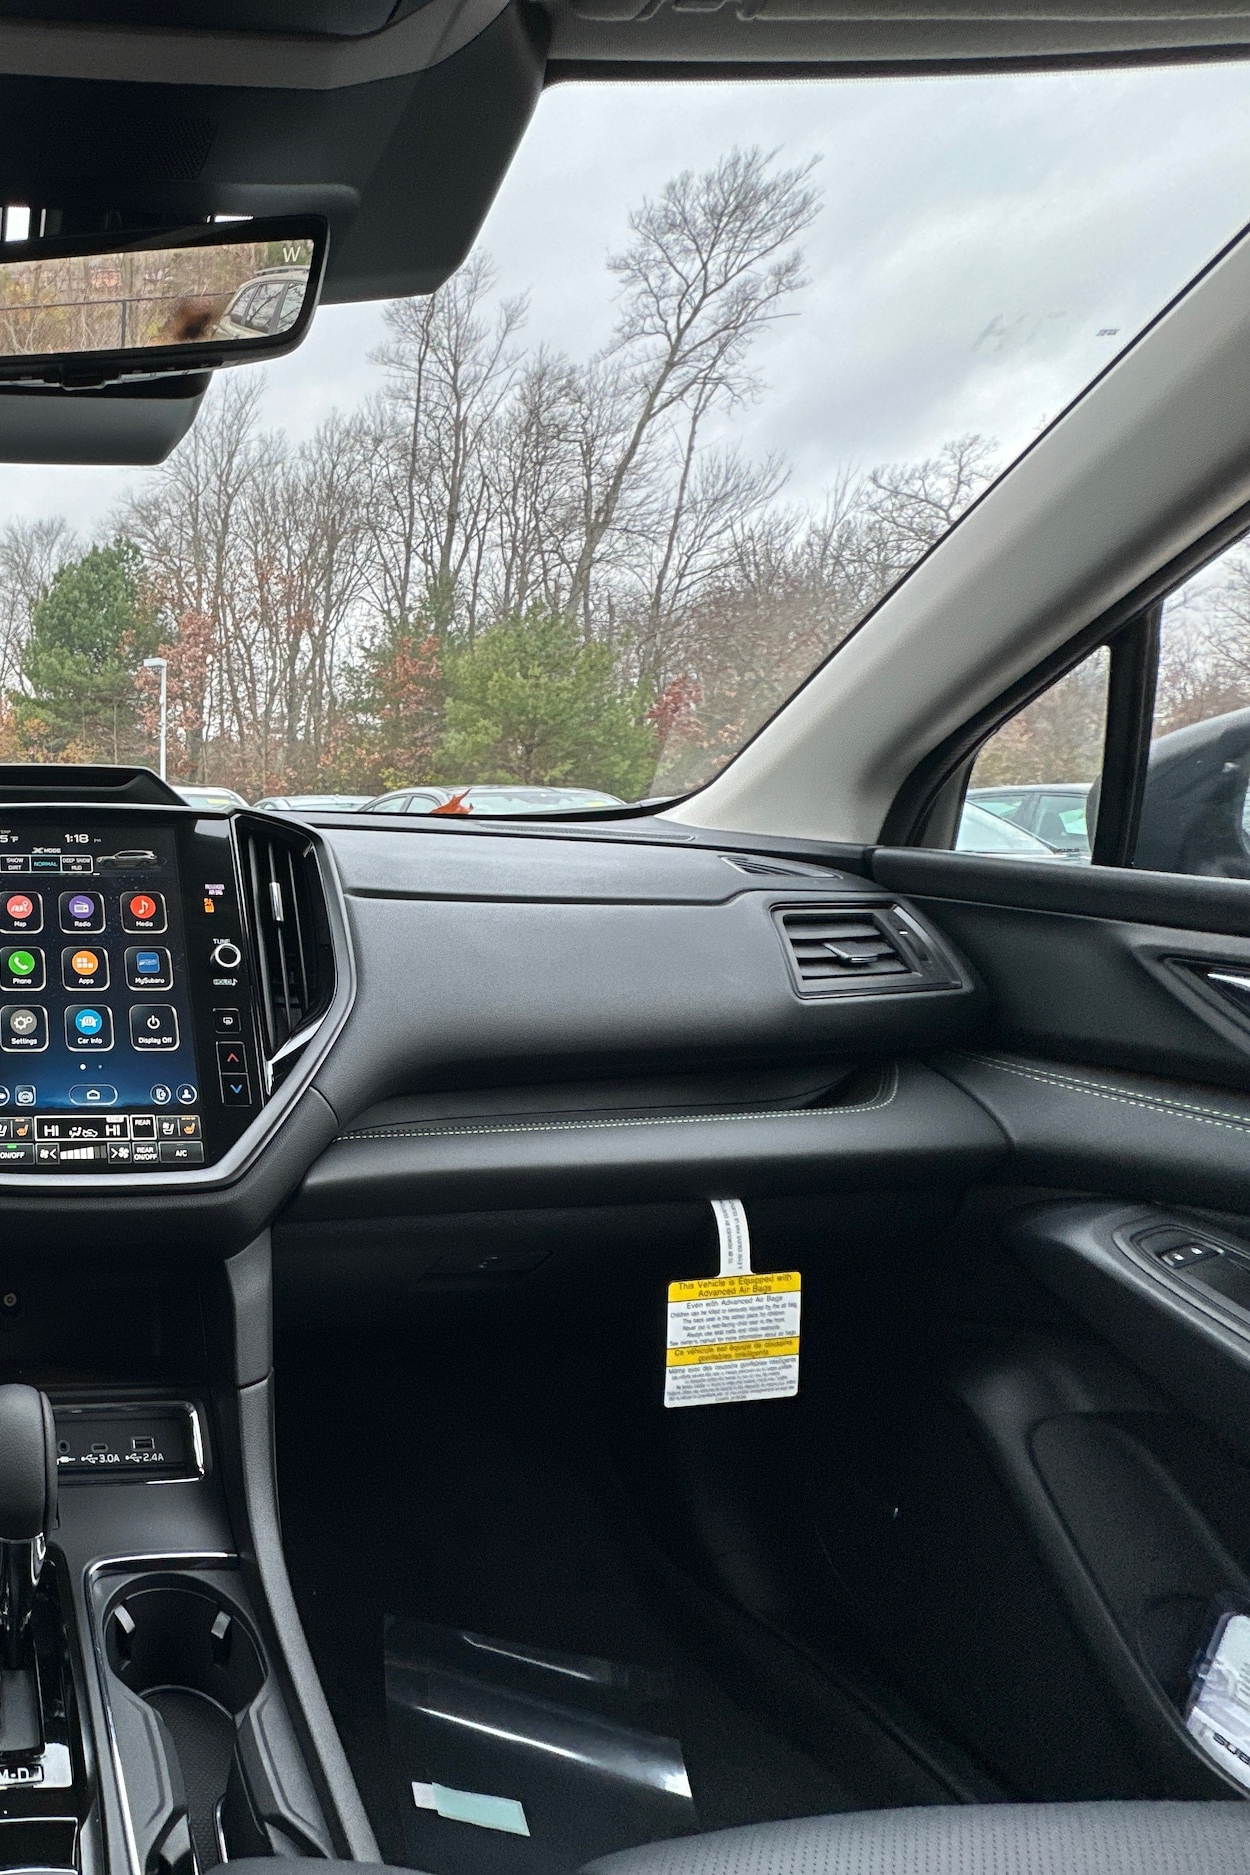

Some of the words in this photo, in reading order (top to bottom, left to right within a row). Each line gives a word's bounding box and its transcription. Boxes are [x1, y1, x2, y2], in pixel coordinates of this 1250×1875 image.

[283, 246, 301, 262] W
[65, 834, 89, 843] 1:18
[135, 977, 165, 985] MySubaru
[11, 1038, 38, 1046] Settings
[138, 1037, 161, 1045] Display
[134, 1153, 158, 1161] ON/OFF
[679, 1282, 695, 1290] This
[697, 1280, 726, 1288] Vehicle
[738, 1275, 774, 1286] Equipped
[777, 1274, 792, 1282] with
[698, 1287, 737, 1297] Advanced
[739, 1285, 751, 1293] Air
[752, 1284, 772, 1293] Bags
[99, 1454, 121, 1463] 3.0A
[143, 1452, 165, 1462] 2.4A
